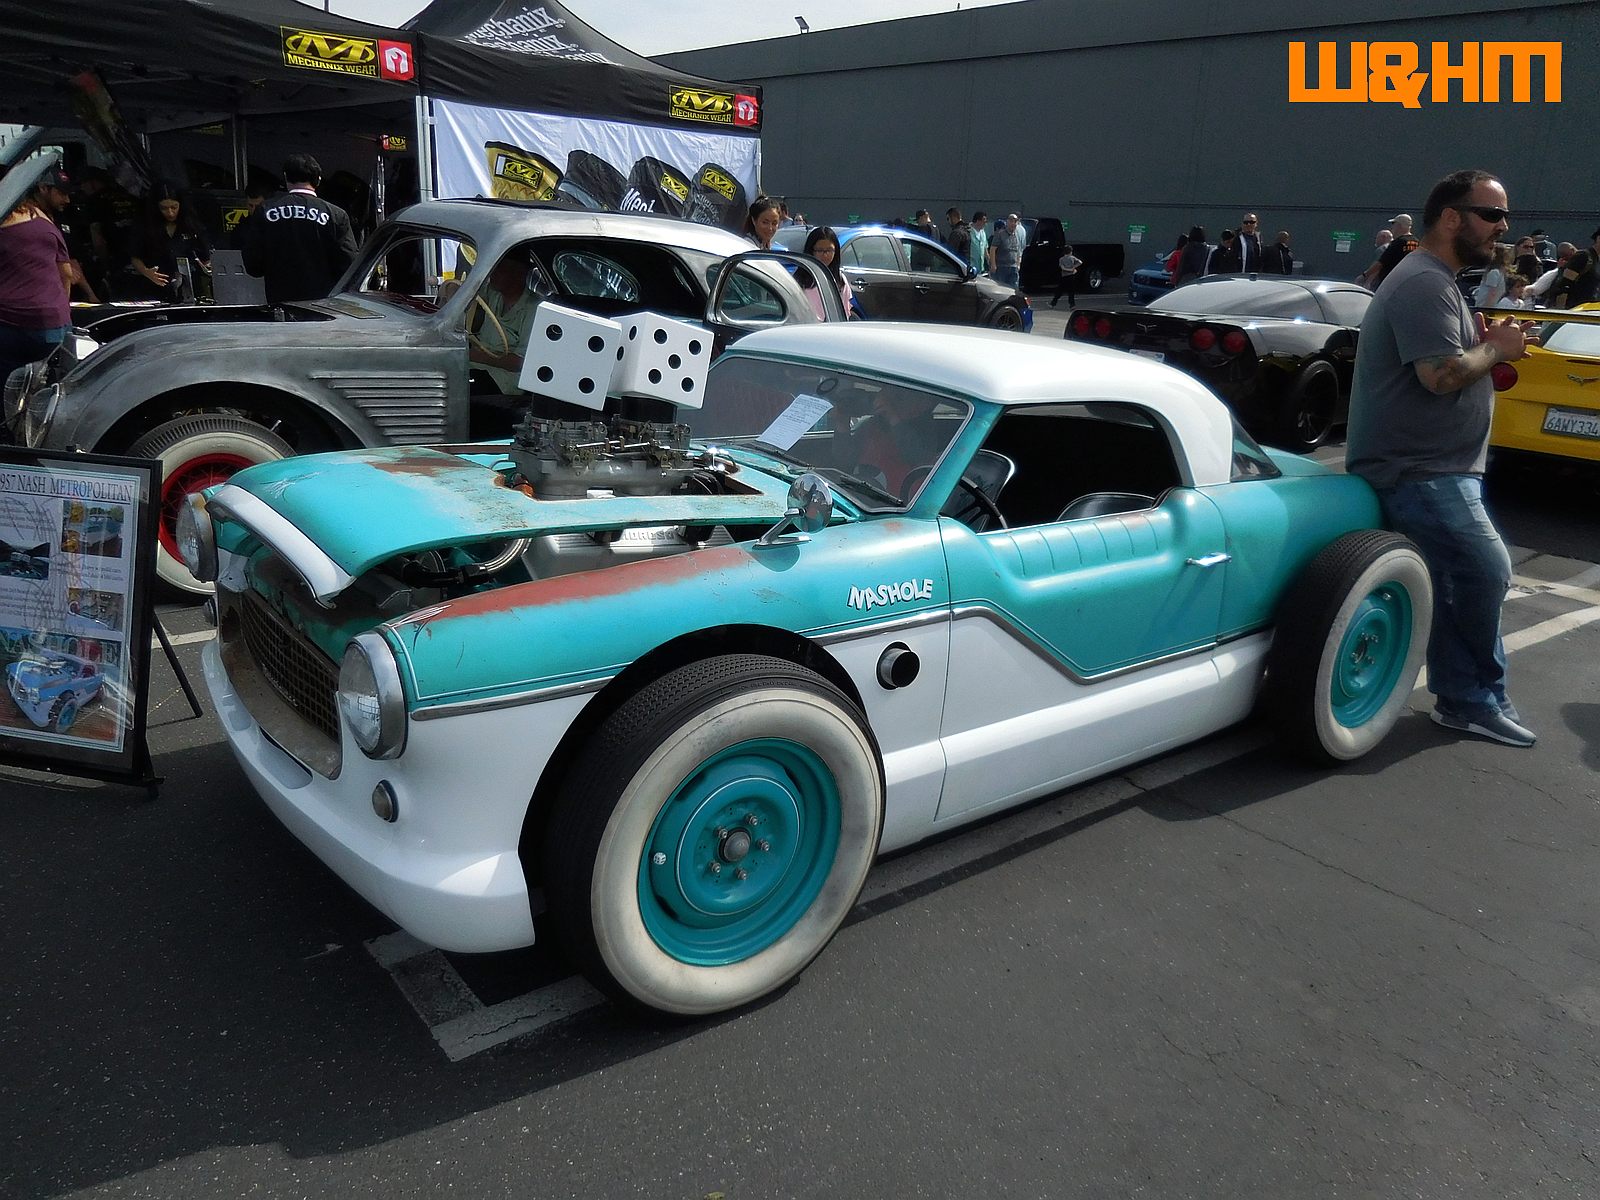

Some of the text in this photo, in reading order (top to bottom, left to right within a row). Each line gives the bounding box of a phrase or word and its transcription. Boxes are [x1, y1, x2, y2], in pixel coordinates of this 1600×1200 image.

[286, 52, 377, 76] MECHANIX WEAR
[672, 106, 732, 123] MECHANIX WEAR
[266, 205, 330, 226] GUESS
[18, 474, 46, 494] NASH
[50, 477, 133, 502] METROPOLITAN
[847, 578, 933, 611] NASHOLE
